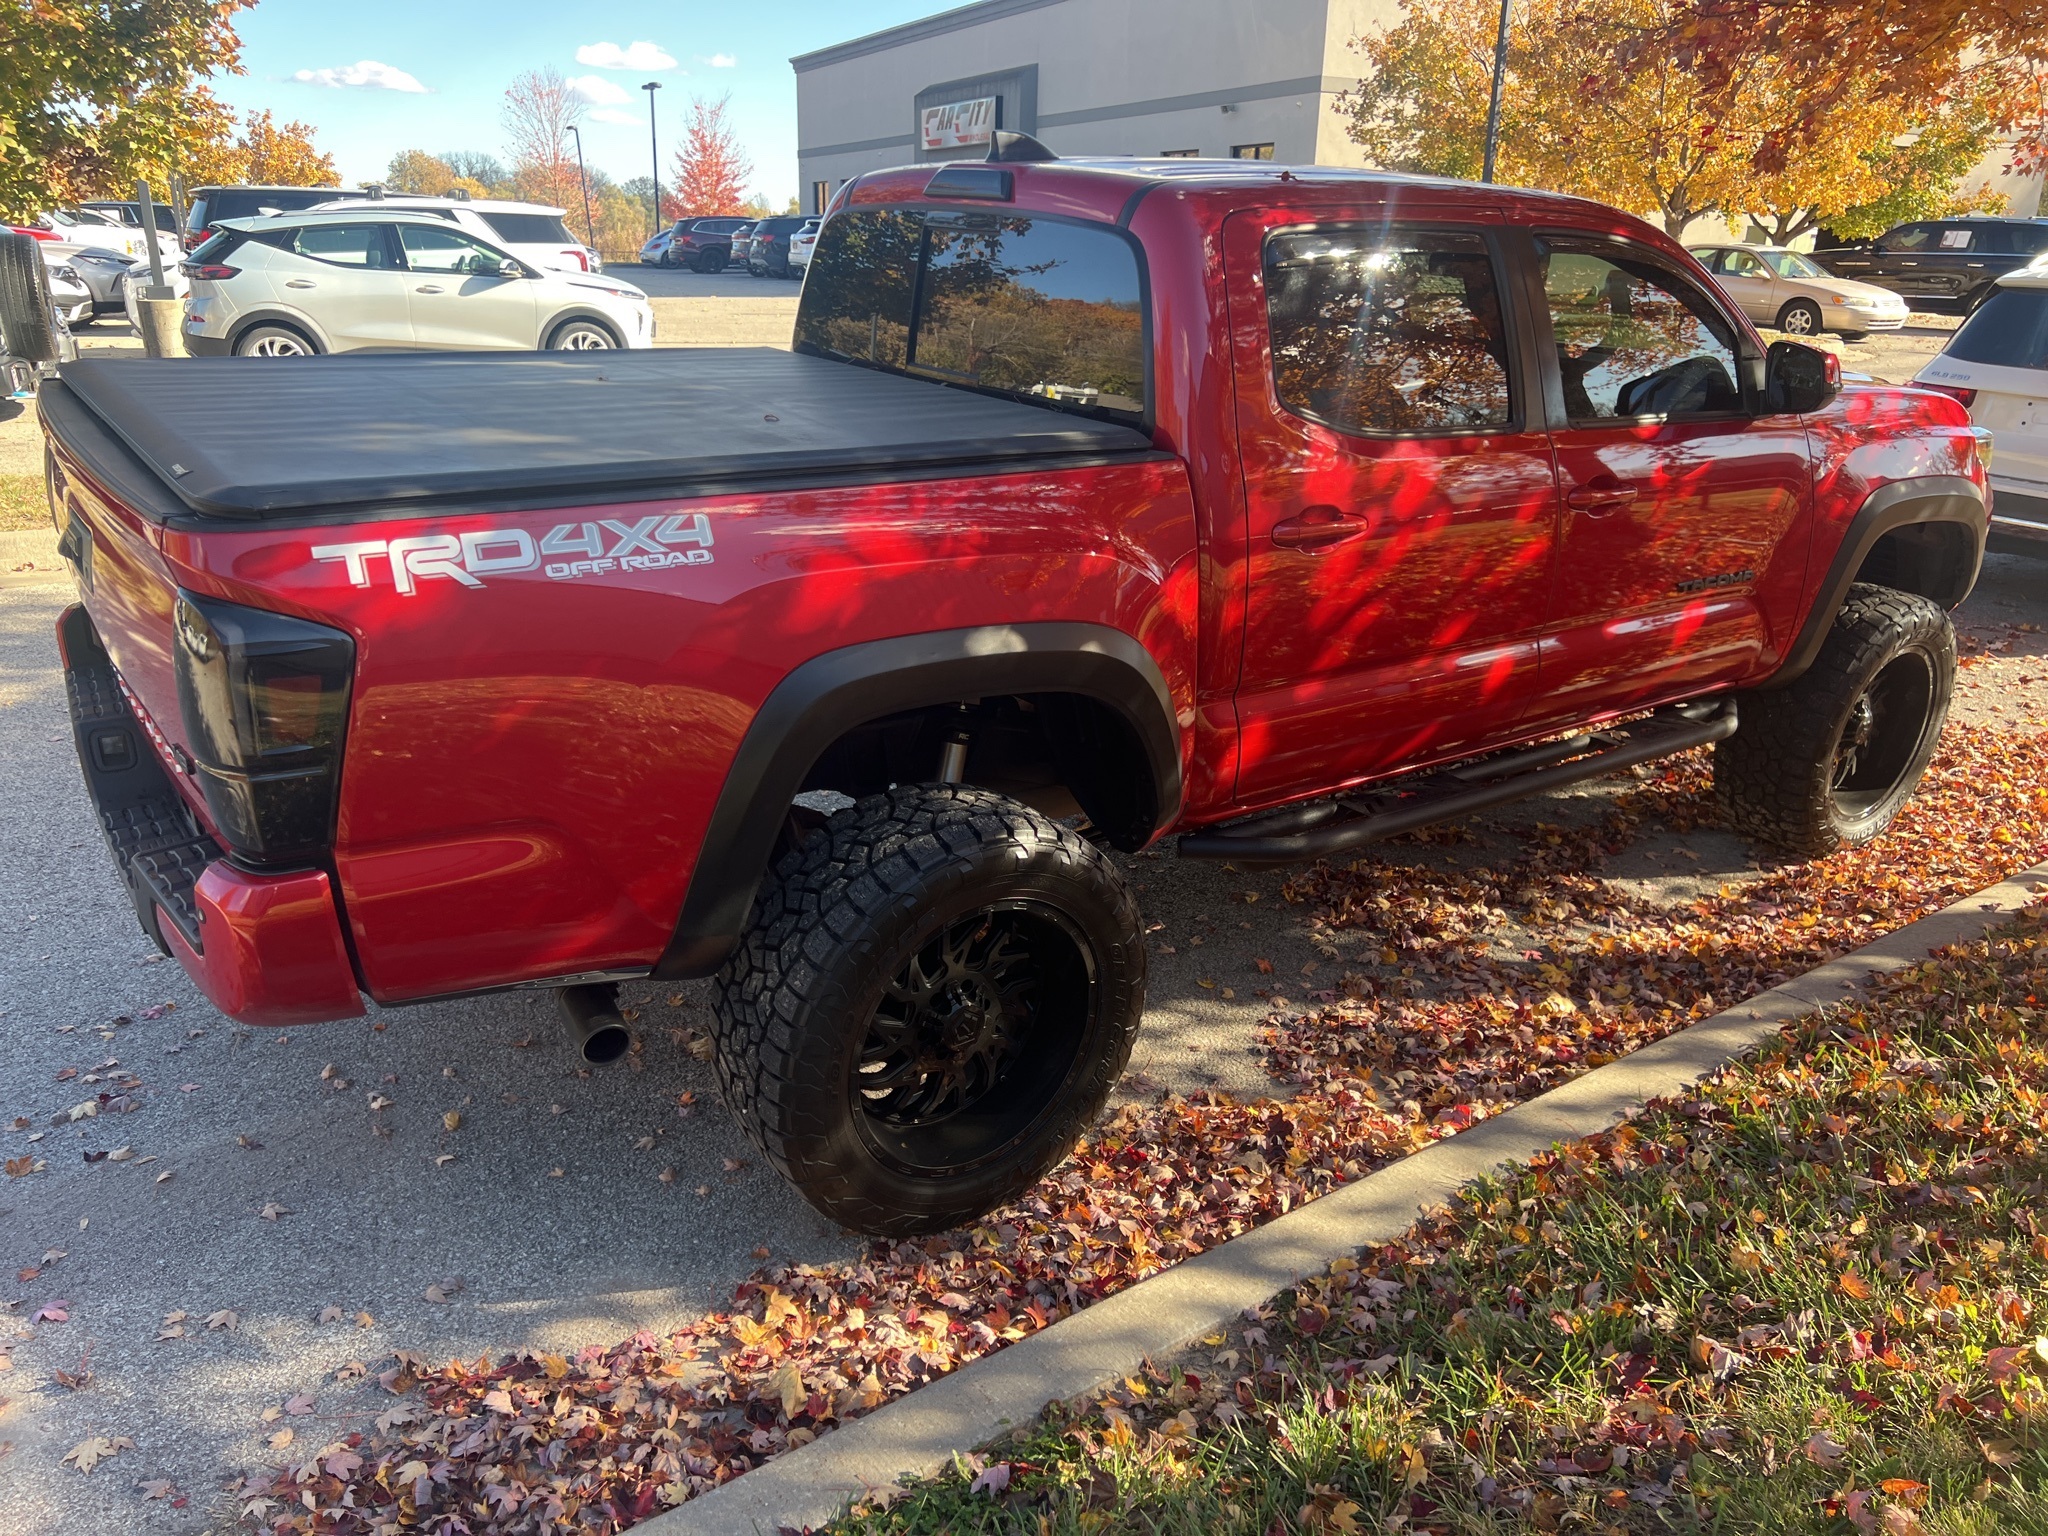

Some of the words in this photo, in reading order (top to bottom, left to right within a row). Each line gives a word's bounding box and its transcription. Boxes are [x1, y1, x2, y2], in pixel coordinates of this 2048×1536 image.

[1950, 373, 1971, 381] 250
[311, 528, 541, 596] TRD
[545, 560, 614, 580] OFF
[621, 549, 714, 574] ROAD
[1676, 569, 1754, 592] TACOMA
